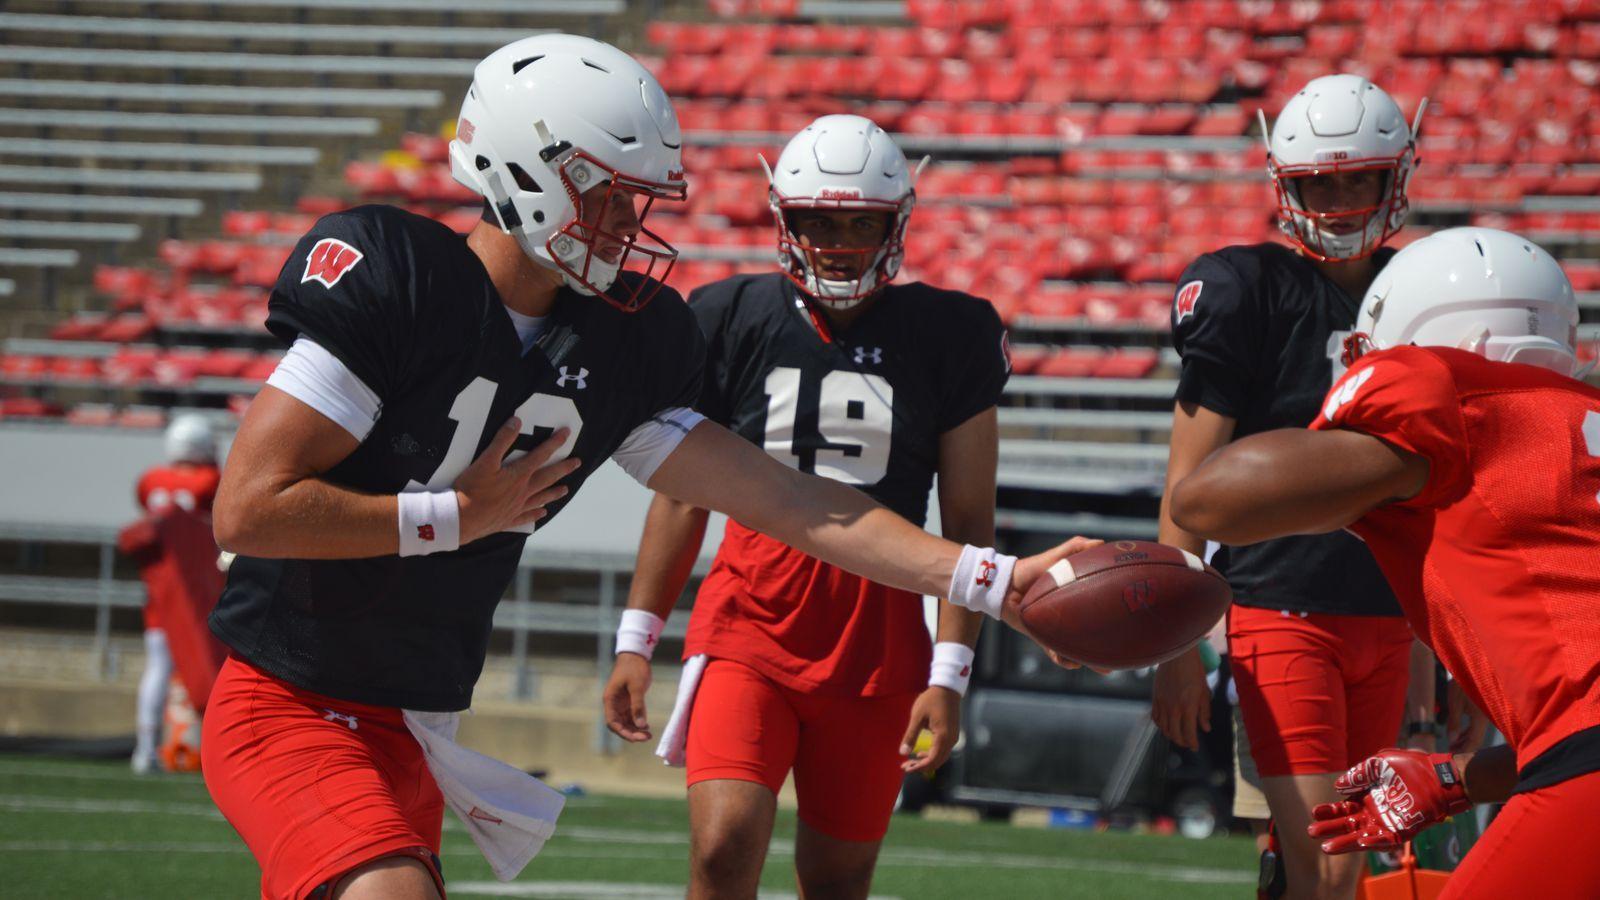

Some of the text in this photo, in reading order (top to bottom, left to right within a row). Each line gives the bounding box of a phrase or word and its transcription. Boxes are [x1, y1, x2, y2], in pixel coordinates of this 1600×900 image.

[301, 238, 363, 289] W
[1176, 280, 1203, 325] W
[763, 366, 893, 485] 19
